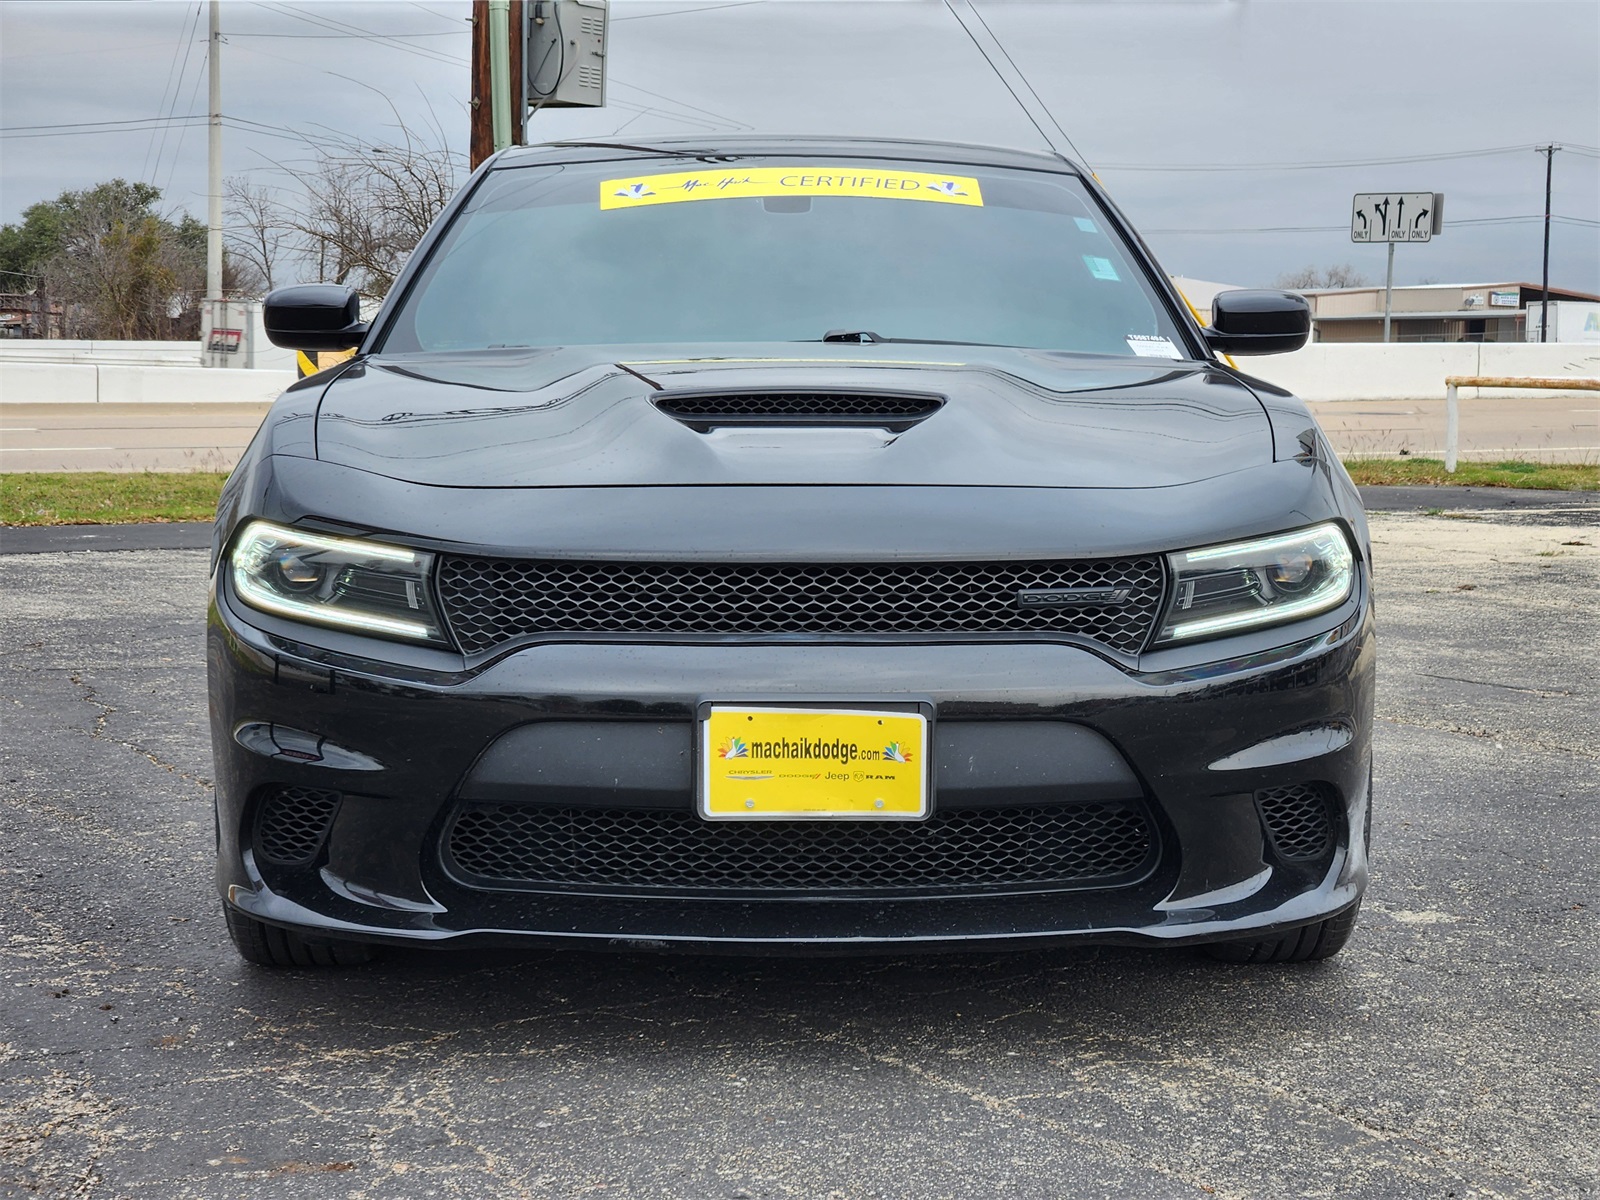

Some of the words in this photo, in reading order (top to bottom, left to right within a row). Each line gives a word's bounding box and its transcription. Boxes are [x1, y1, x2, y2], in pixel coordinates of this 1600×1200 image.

[780, 174, 920, 192] CERTIFIED
[1353, 230, 1369, 239] ONLY
[1391, 230, 1406, 239] ONLY
[1411, 230, 1429, 239] ONLY
[1024, 592, 1115, 603] DODGE
[751, 737, 880, 765] machaikdodge.com
[824, 771, 850, 782] Jeep
